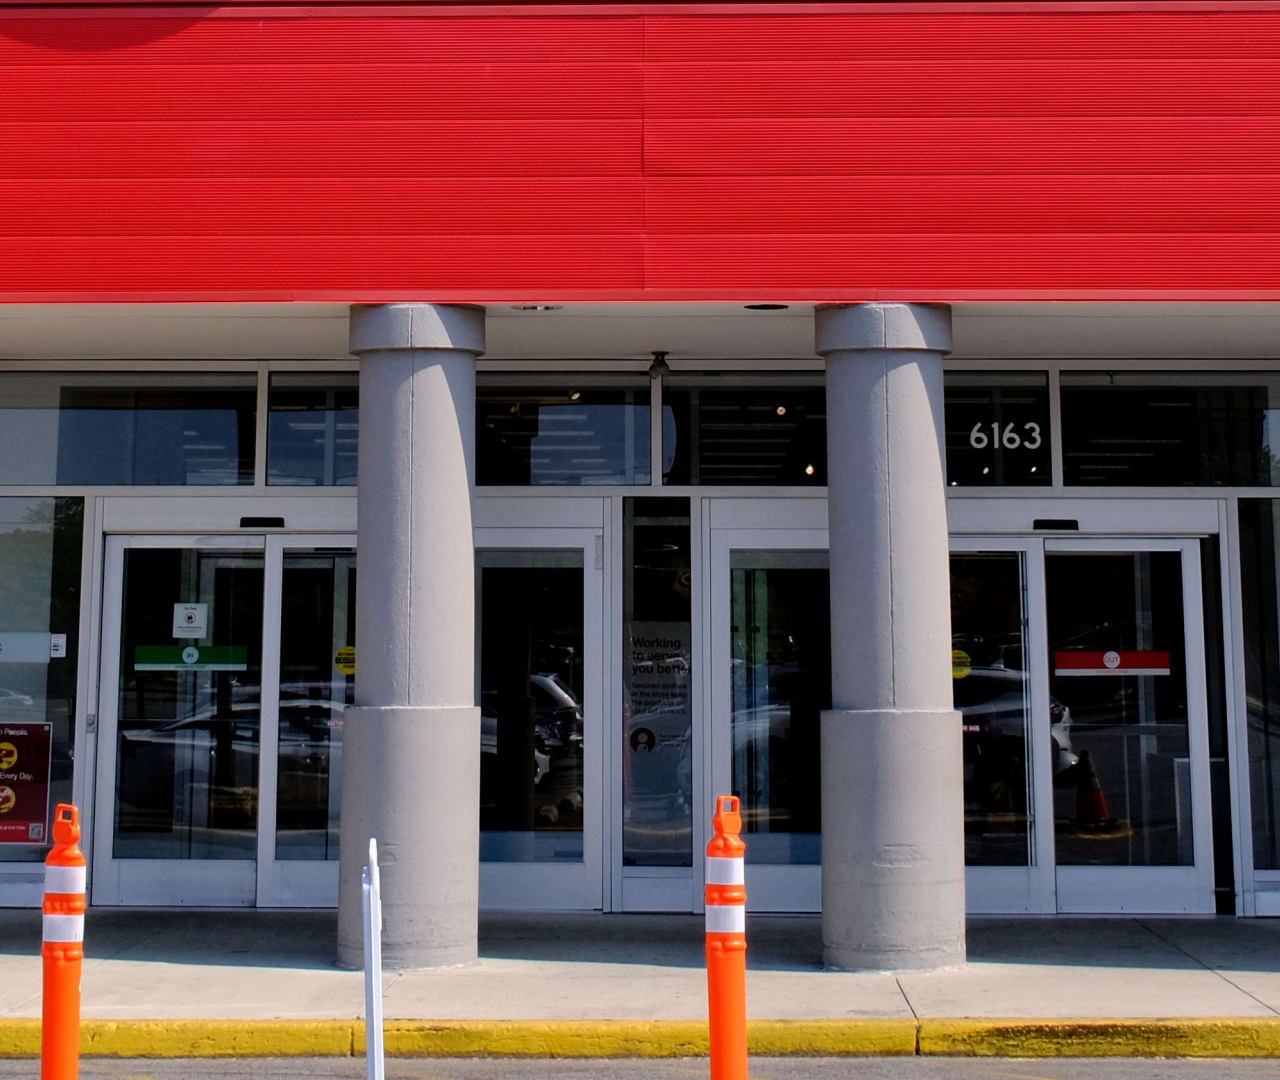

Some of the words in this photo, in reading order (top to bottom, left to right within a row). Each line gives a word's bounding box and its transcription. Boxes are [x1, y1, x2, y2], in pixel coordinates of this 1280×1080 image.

[970, 422, 1041, 449] 6163
[632, 637, 681, 650] Working
[632, 651, 644, 660] to
[632, 665, 654, 675] you
[0, 772, 18, 781] Every
